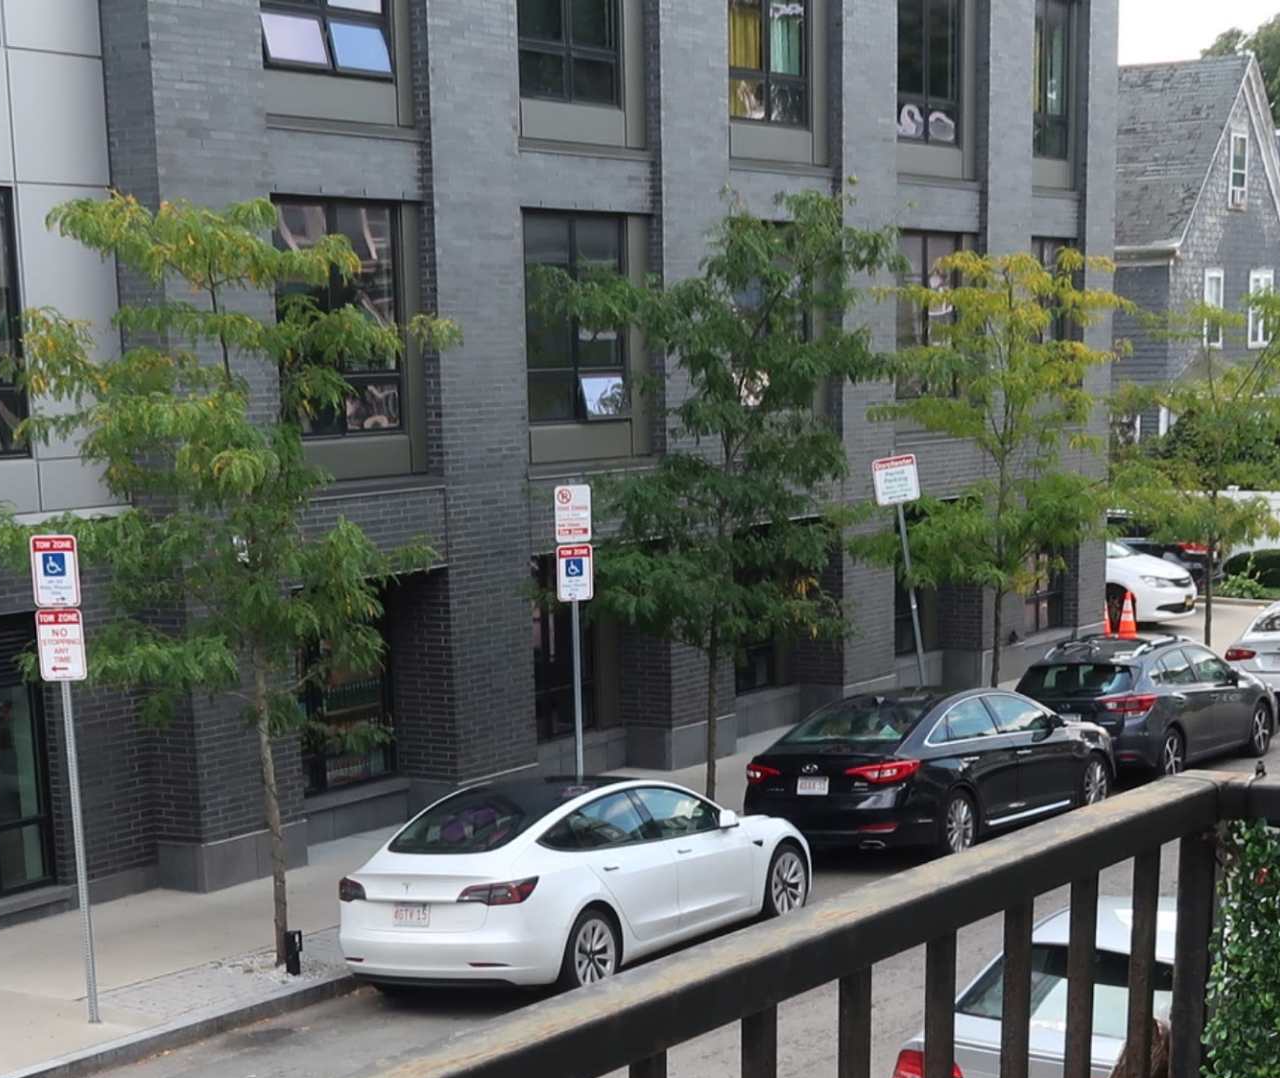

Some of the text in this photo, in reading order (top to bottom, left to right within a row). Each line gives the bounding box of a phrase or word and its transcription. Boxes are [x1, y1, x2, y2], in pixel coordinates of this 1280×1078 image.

[35, 540, 72, 549] TOW ZONE
[39, 613, 79, 623] TOW ZONE
[51, 628, 68, 637] NO
